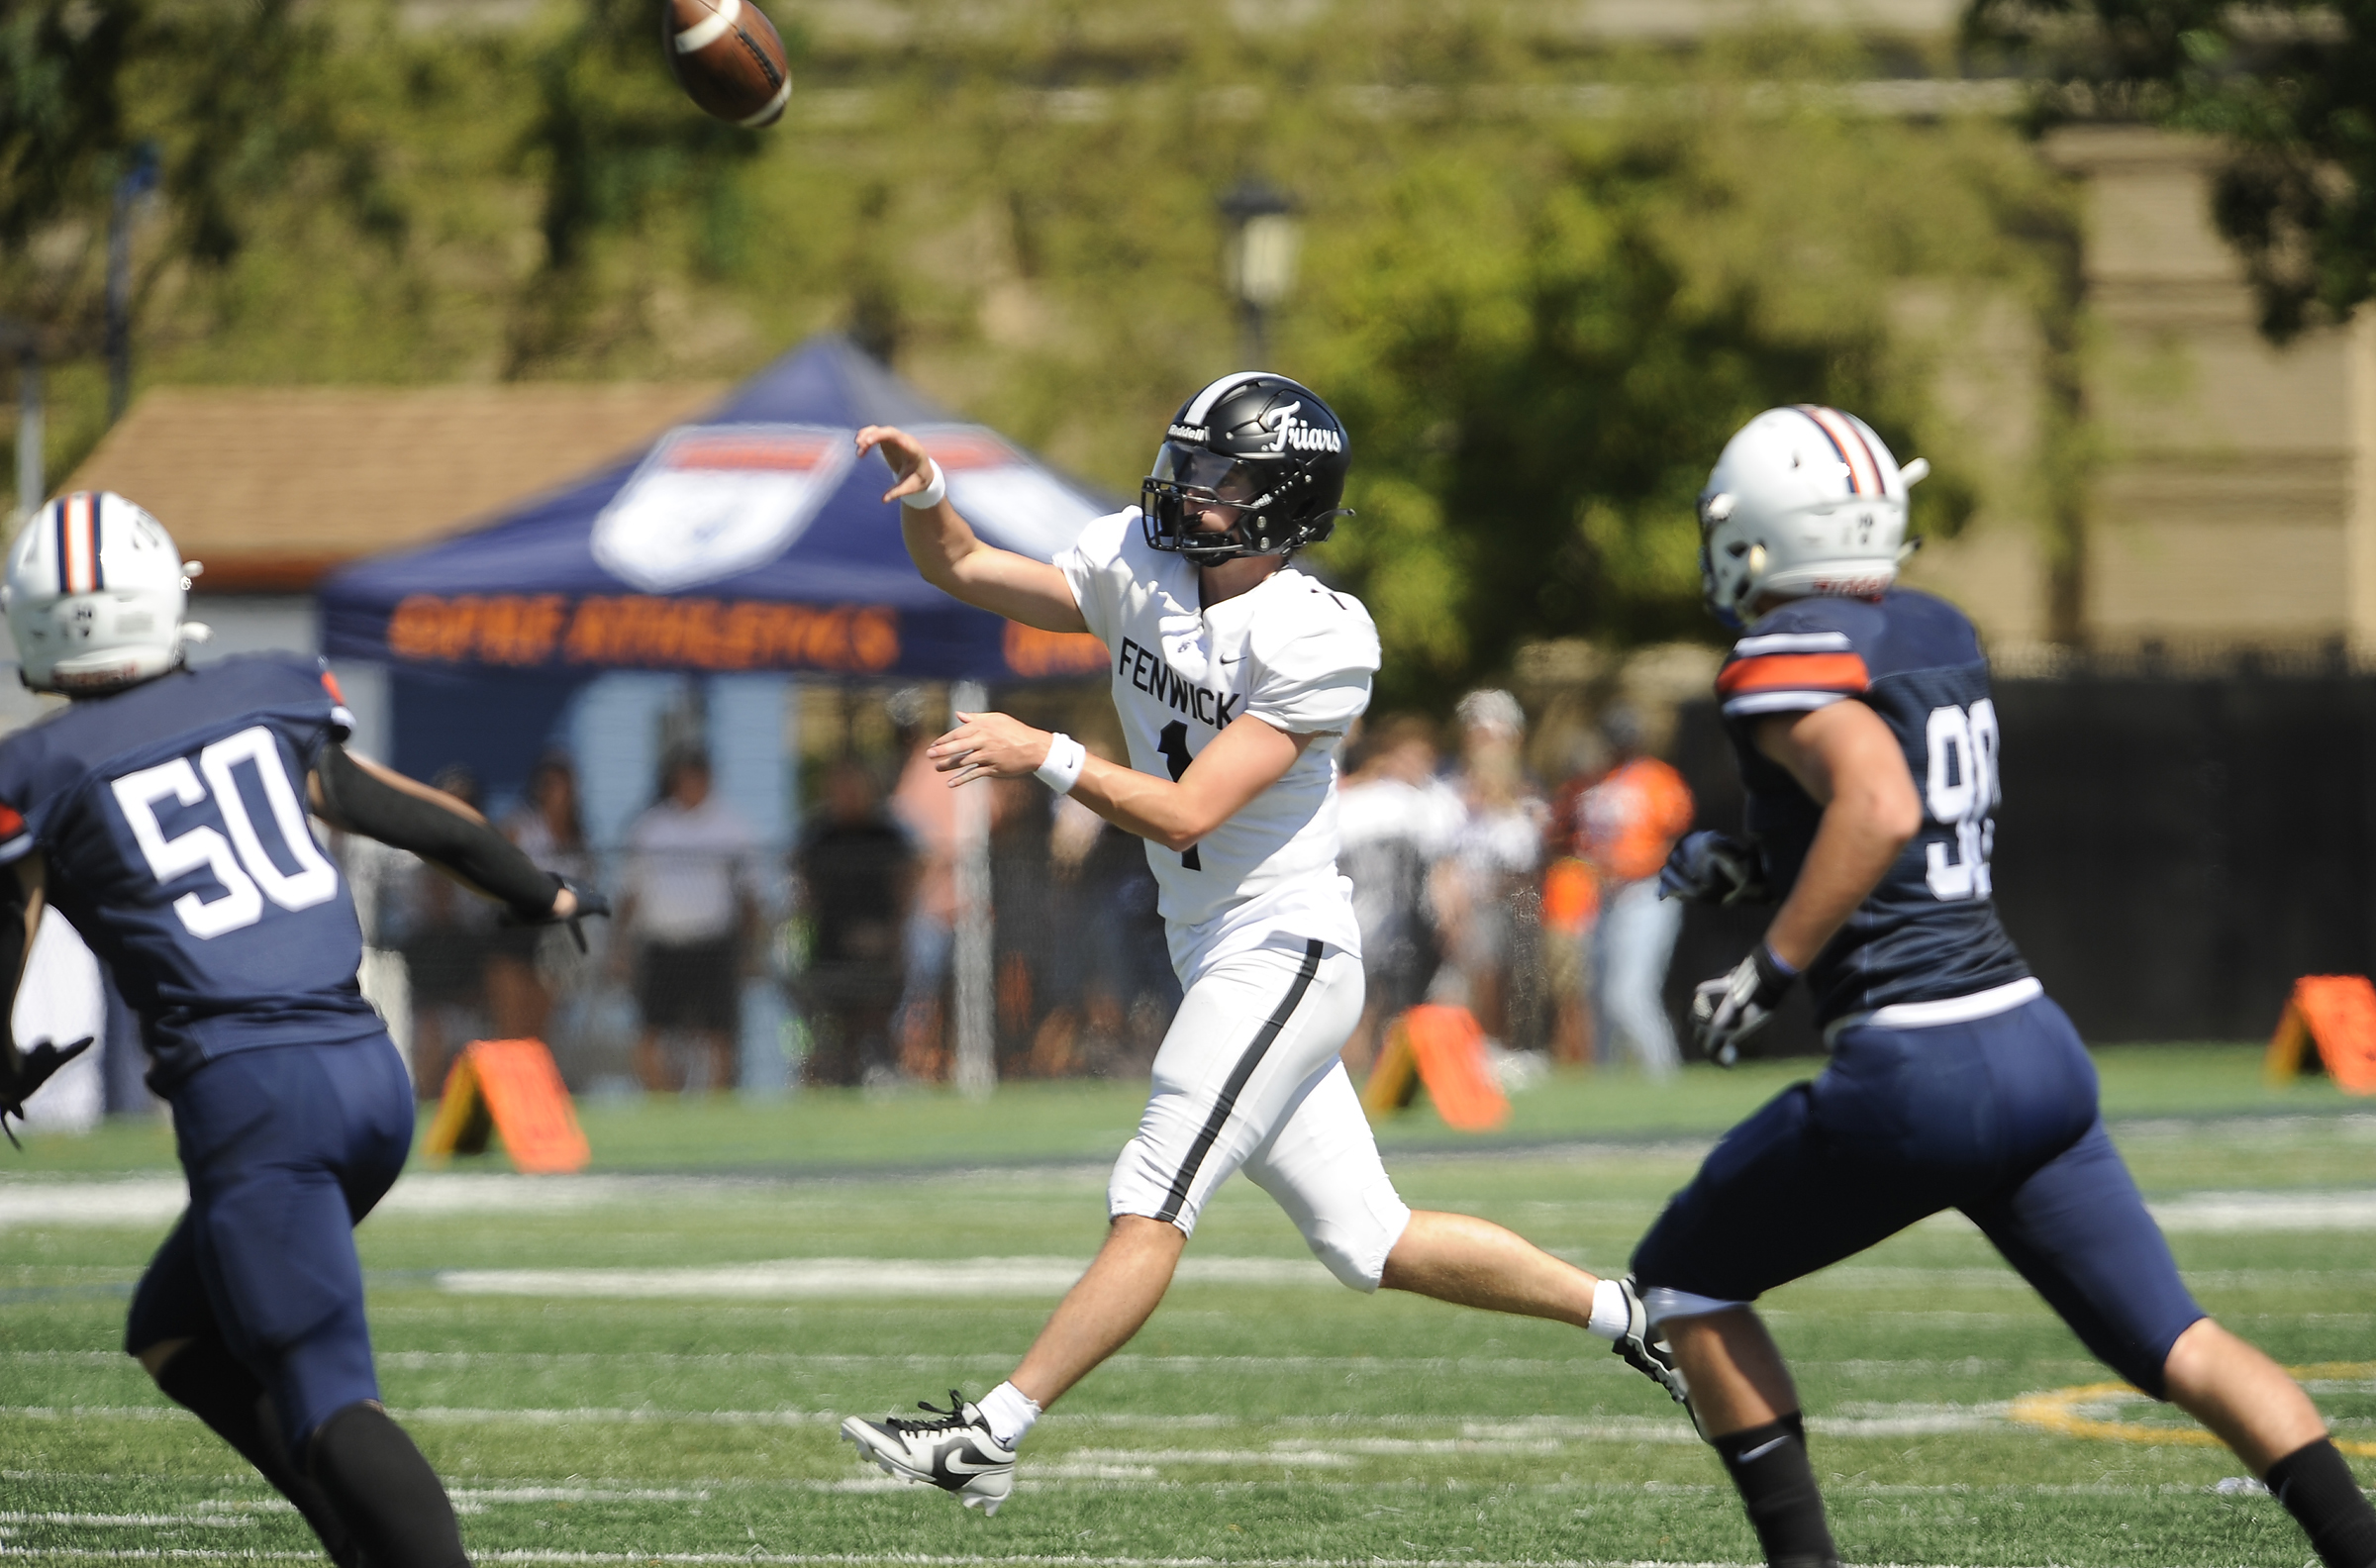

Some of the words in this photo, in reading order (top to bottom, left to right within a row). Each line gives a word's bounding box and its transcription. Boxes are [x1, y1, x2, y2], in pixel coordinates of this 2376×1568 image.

[1267, 400, 1342, 453] Friars
[1119, 637, 1240, 731] FENWICK
[110, 725, 340, 940] 50
[1157, 719, 1201, 871] 1
